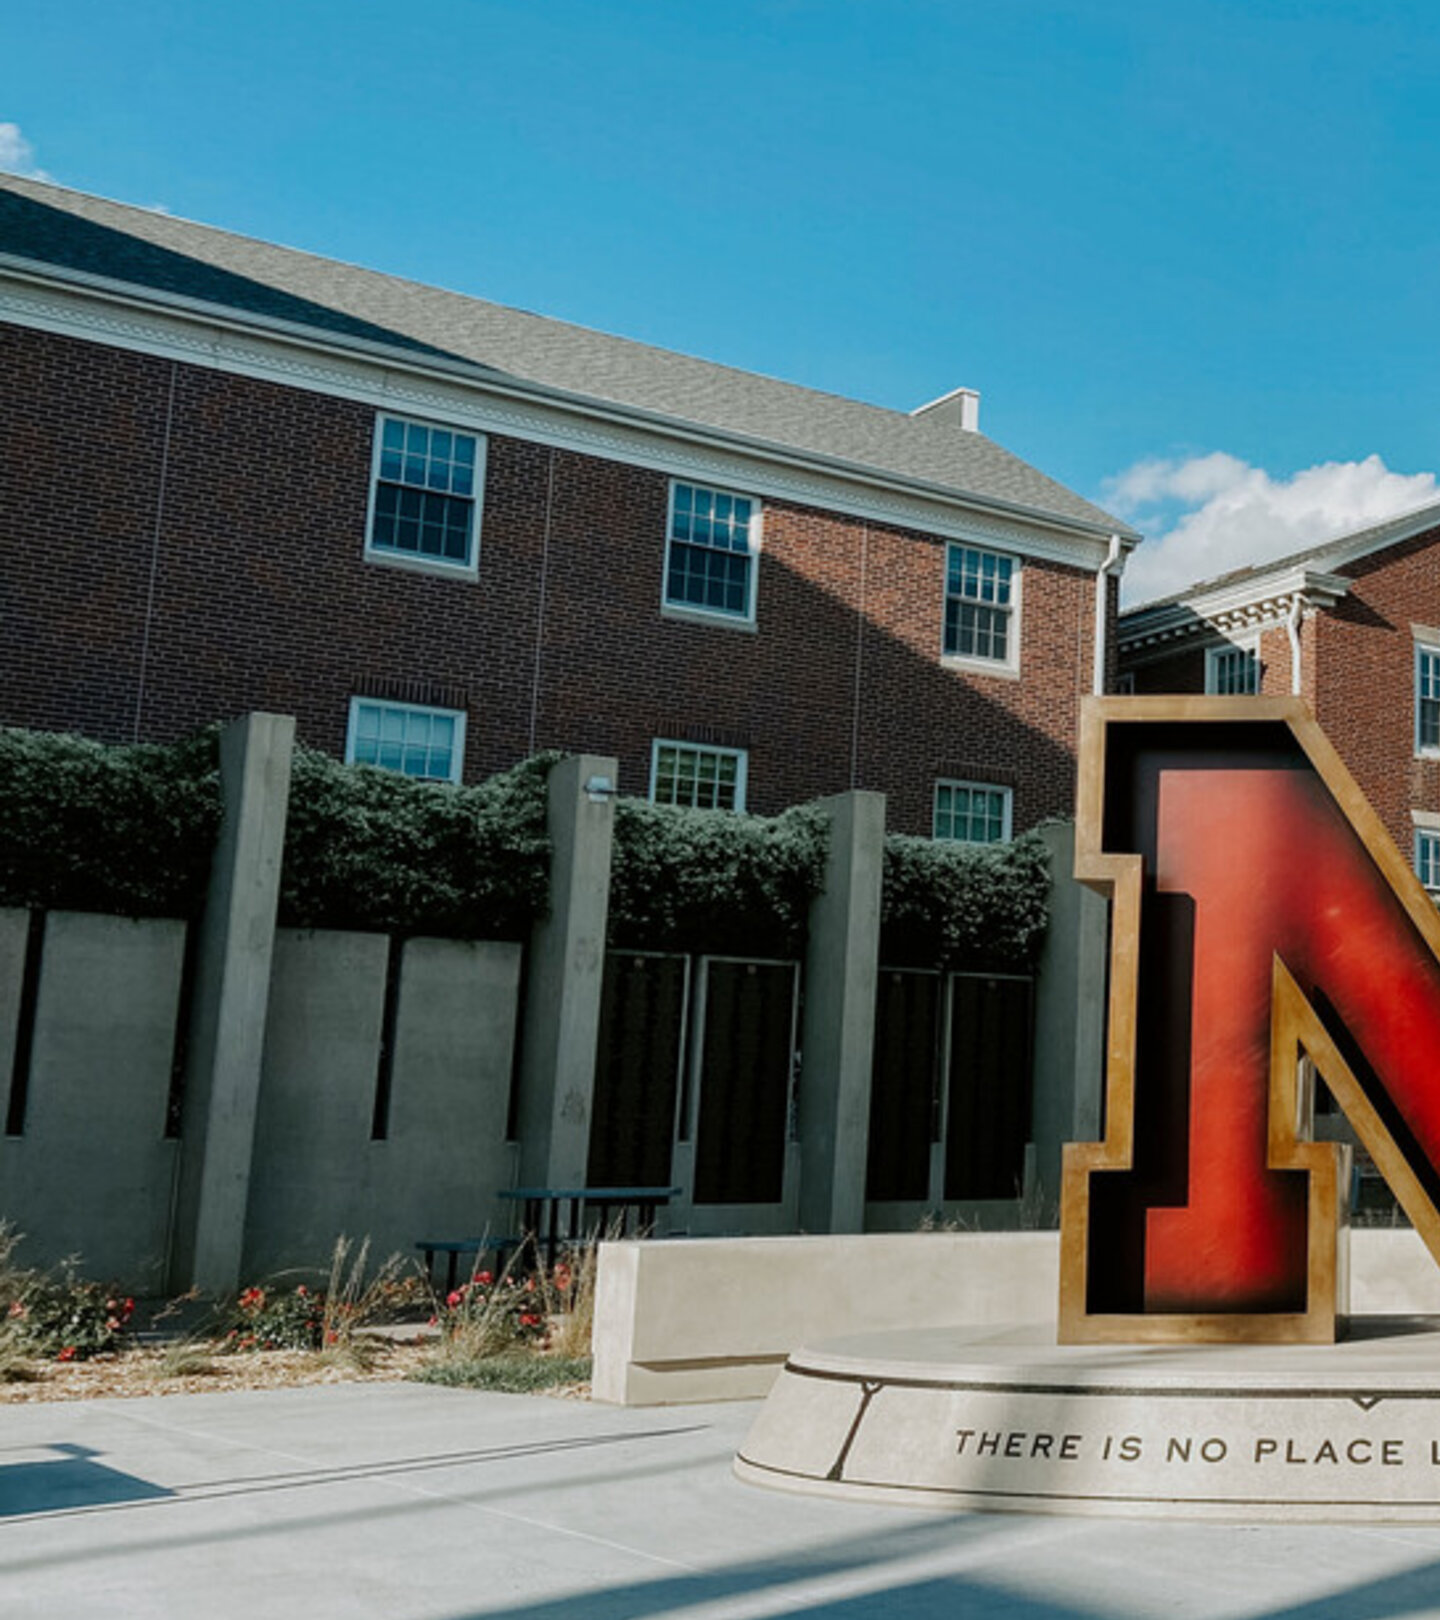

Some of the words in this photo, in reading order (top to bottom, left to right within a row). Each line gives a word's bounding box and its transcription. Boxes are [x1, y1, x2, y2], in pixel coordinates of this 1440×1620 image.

[956, 1429, 1083, 1460] THERE
[1102, 1435, 1143, 1462] IS
[1165, 1437, 1228, 1464] NO
[1254, 1438, 1404, 1466] PLACE
